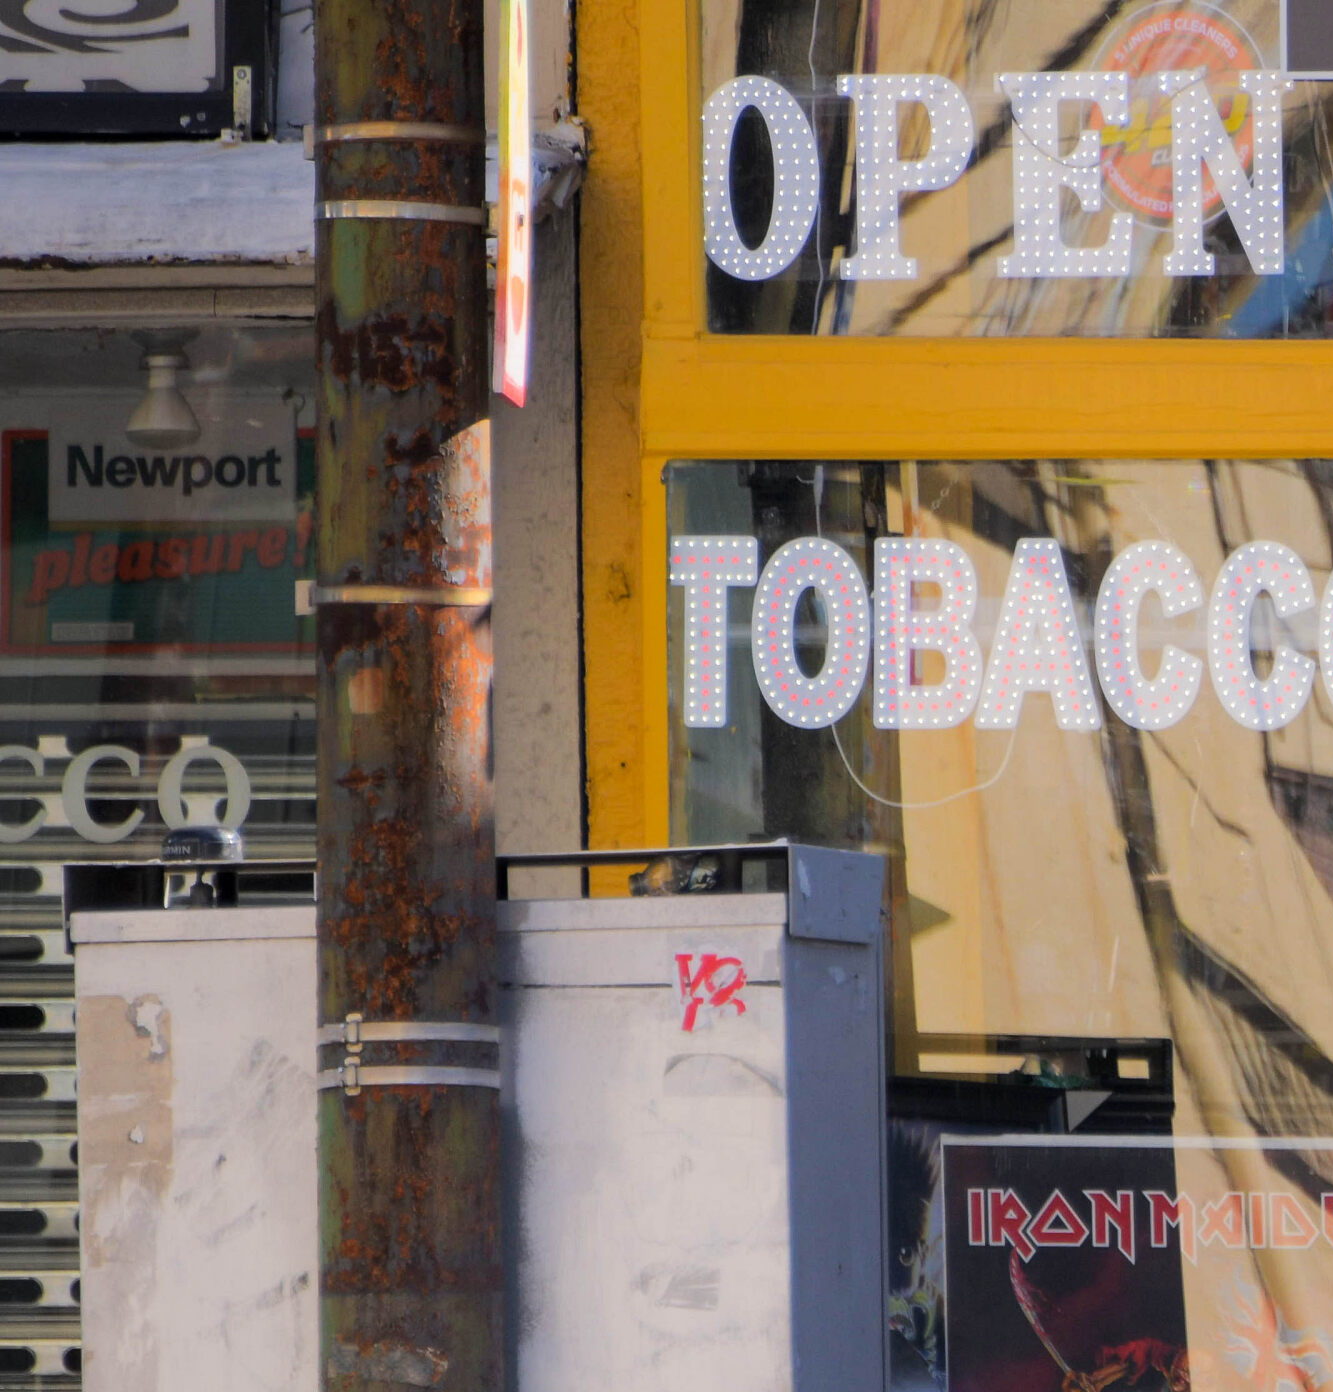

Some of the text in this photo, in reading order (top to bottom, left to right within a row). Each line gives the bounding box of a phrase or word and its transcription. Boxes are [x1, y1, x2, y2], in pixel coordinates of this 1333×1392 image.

[1123, 20, 1172, 51] UNIQUE
[1174, 17, 1238, 59] CLEANERS
[703, 70, 1292, 280] OPEN
[66, 444, 282, 495] Newport
[966, 1187, 1137, 1265] IRON
